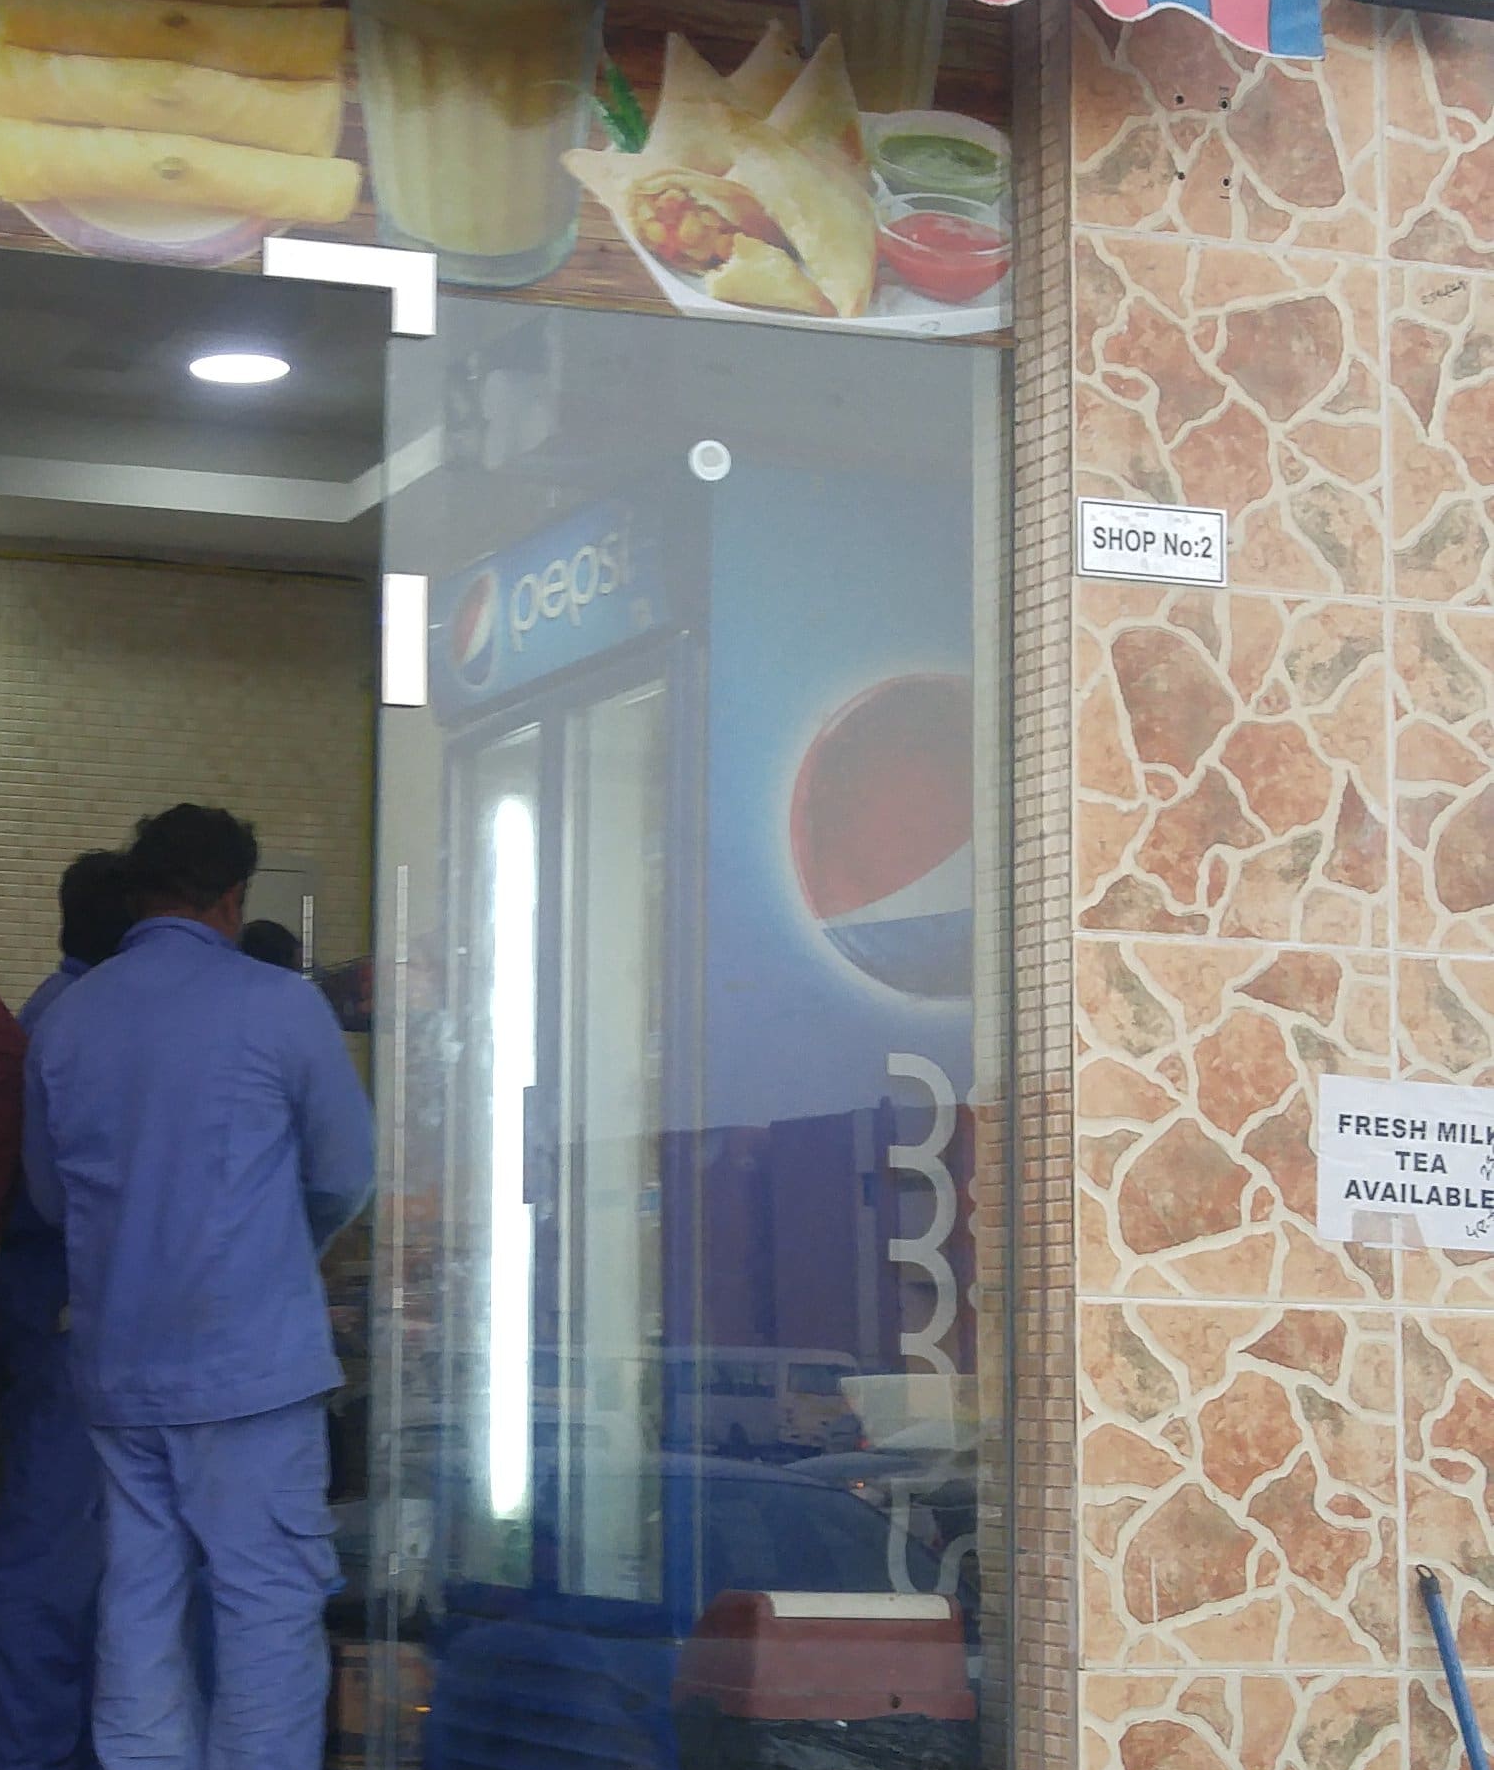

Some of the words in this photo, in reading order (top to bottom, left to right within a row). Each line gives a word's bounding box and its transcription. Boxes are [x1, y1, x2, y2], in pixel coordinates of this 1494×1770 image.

[1092, 526, 1156, 553] SHOP
[1163, 532, 1213, 559] No:2
[509, 511, 633, 653] pepsi
[1338, 1113, 1427, 1140] FRESH
[1437, 1122, 1494, 1146] MILK
[1395, 1150, 1448, 1175] TEA
[1344, 1179, 1494, 1210] AVAILABLE
